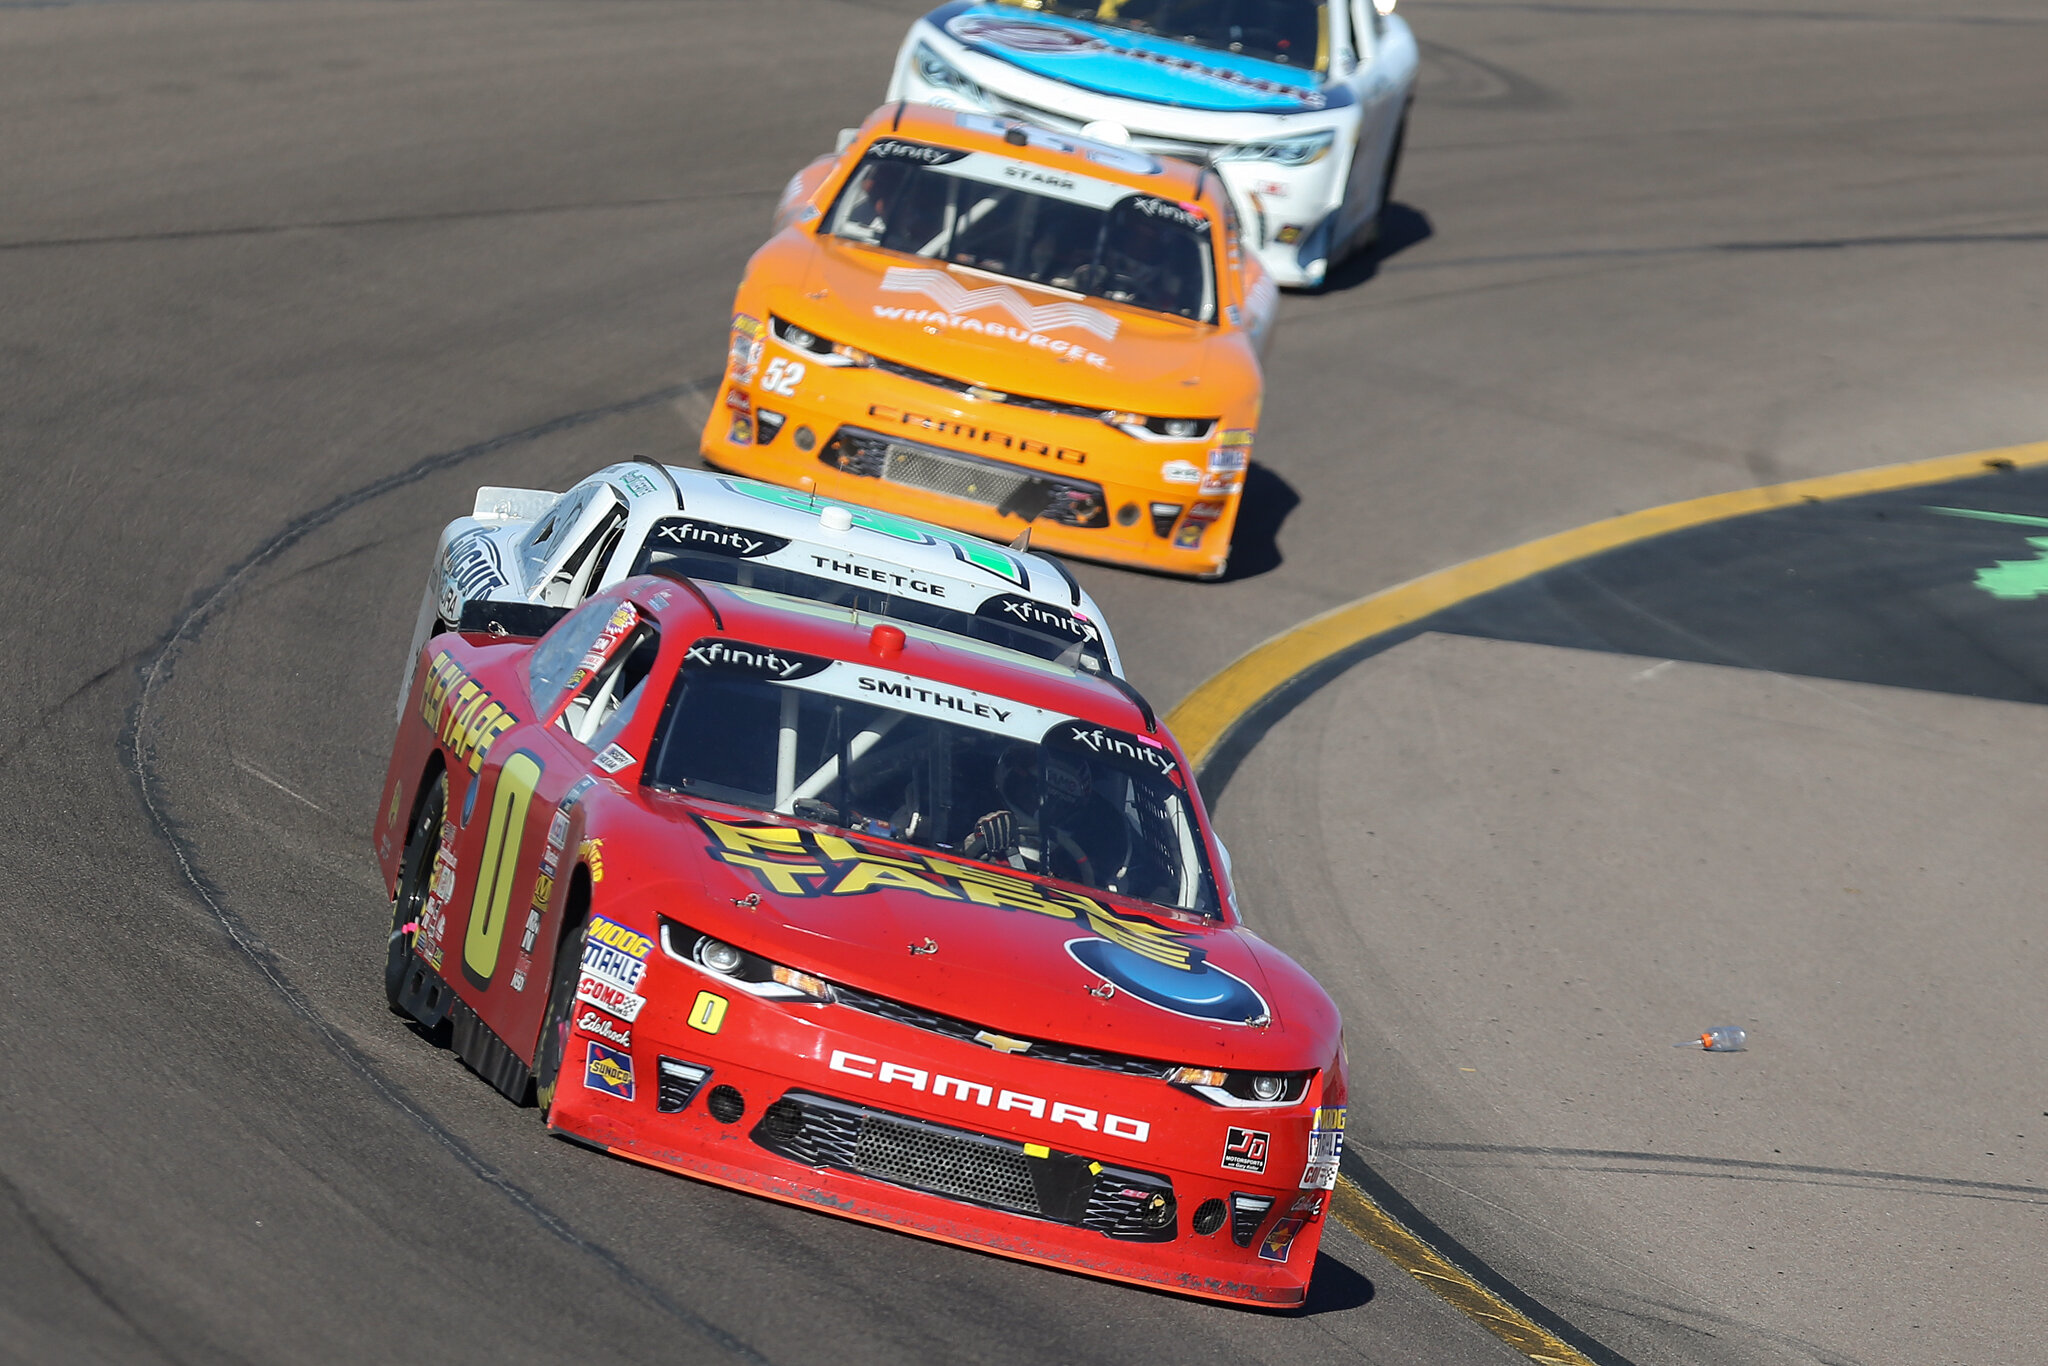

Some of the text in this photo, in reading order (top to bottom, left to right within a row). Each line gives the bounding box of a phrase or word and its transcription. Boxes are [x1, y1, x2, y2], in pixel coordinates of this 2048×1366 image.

[869, 139, 949, 164] xfinity
[1005, 166, 1075, 190] STARR
[1133, 196, 1213, 232] xfinity
[872, 305, 1111, 370] WHATABURGER
[761, 357, 805, 397] 52
[868, 404, 1087, 464] CAMARO
[657, 523, 764, 554] xfinity
[810, 554, 946, 597] THEETGE
[1002, 600, 1095, 643] xfinity
[684, 643, 803, 678] xfinity
[858, 676, 1013, 723] SMITHLEY
[442, 679, 518, 775] TAPE
[1071, 727, 1176, 775] xfinity
[588, 917, 656, 959] MOOG
[584, 943, 642, 985] MAHLE
[578, 977, 626, 1007] COMP
[592, 1061, 630, 1083] SUNOCO
[829, 1049, 1150, 1143] CAMARO
[1225, 1155, 1264, 1167] MOTORSPORTS
